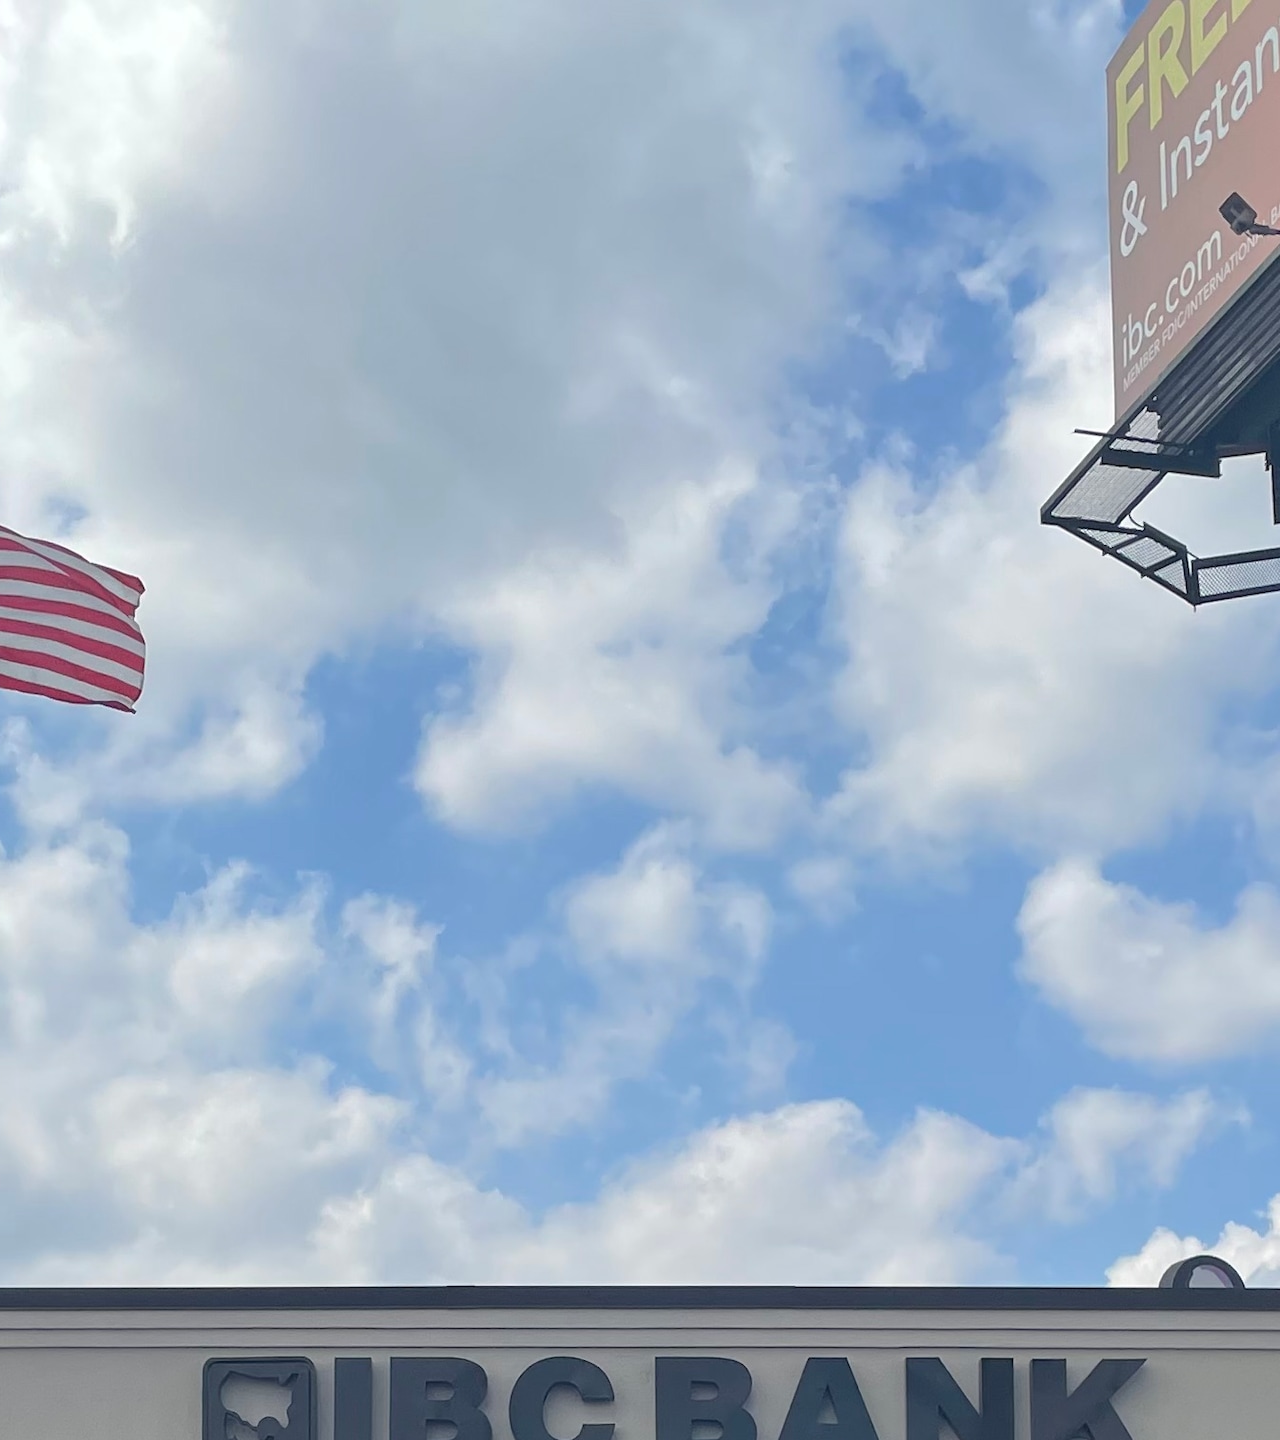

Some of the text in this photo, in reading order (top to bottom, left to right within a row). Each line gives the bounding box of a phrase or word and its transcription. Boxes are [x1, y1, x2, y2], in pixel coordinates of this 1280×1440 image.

[1116, 0, 1254, 174] FRE
[1121, 180, 1148, 257] &
[1123, 230, 1222, 368] ibc.com
[1123, 338, 1160, 392] MEMBER
[1162, 219, 1266, 347] FDIC/INTERNATION
